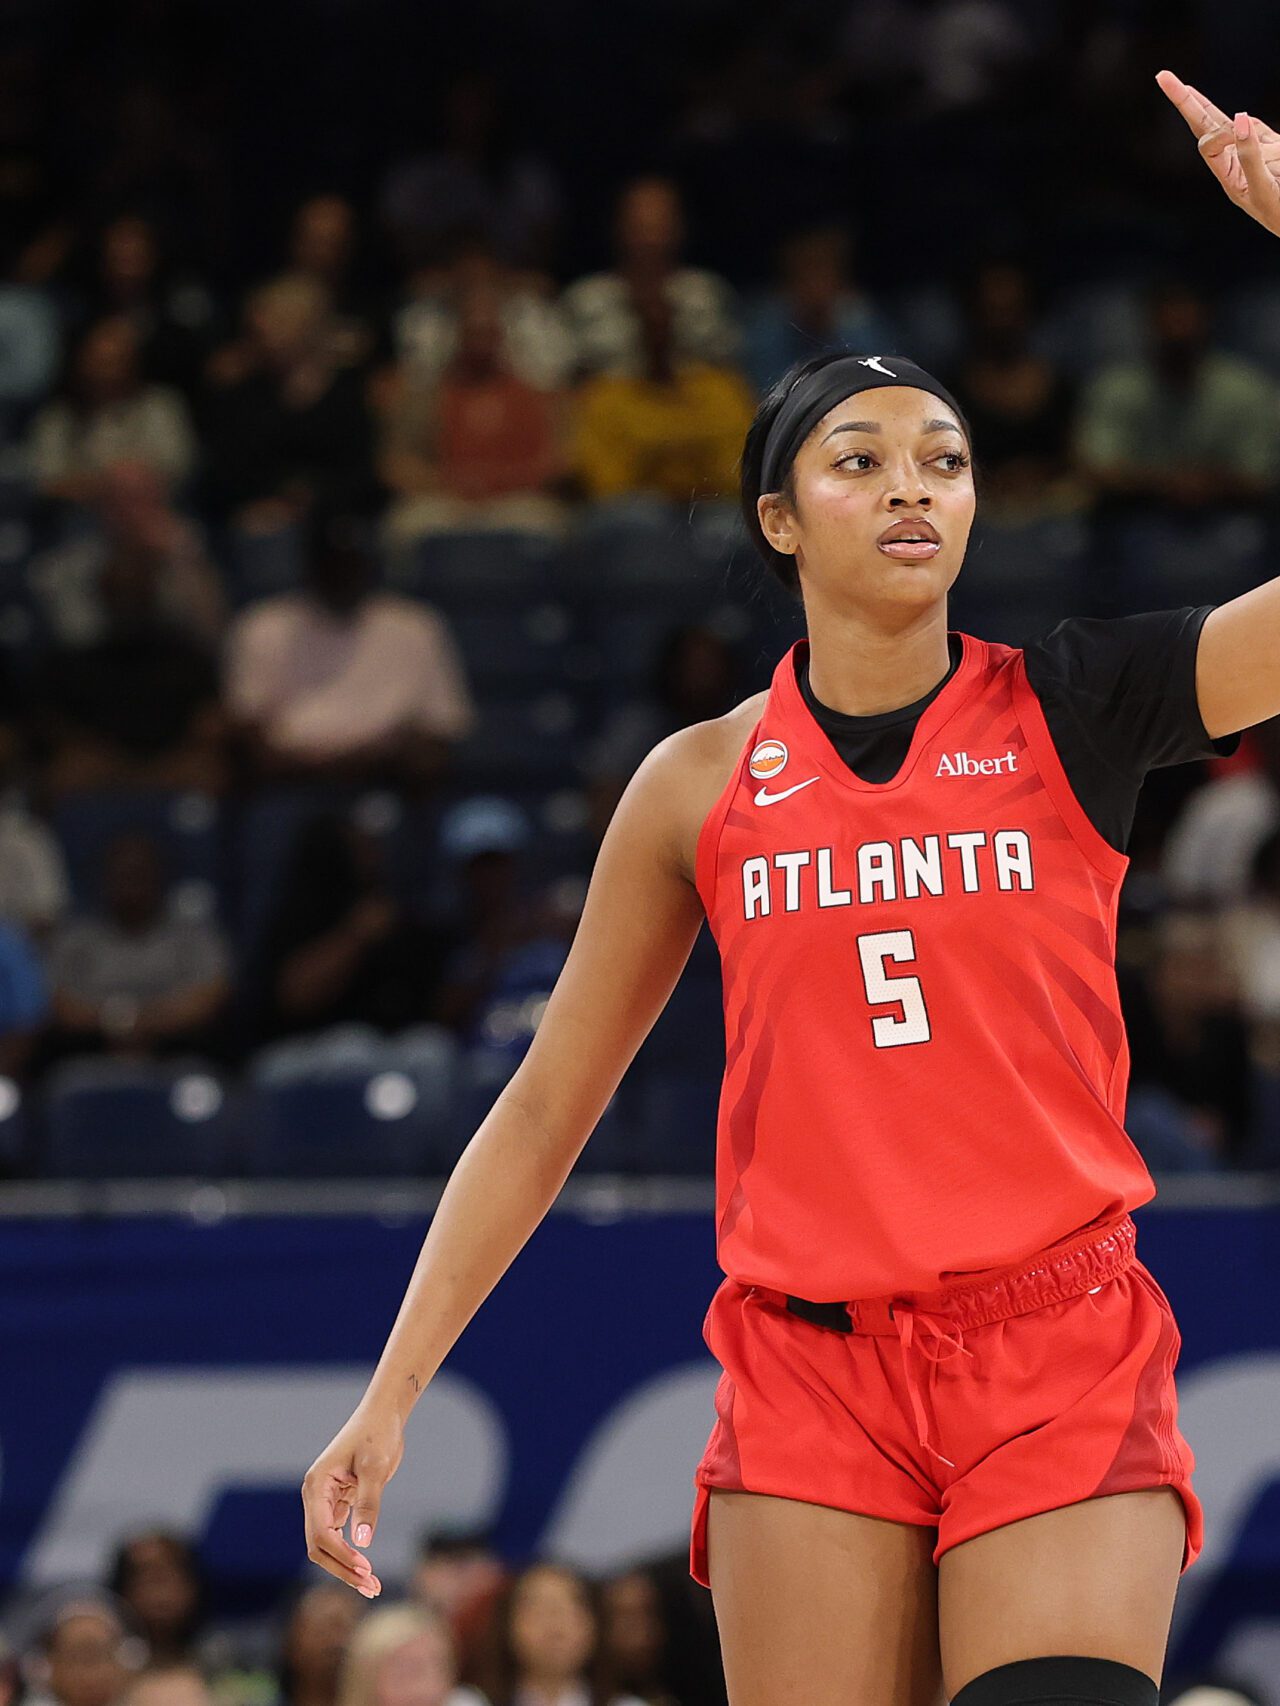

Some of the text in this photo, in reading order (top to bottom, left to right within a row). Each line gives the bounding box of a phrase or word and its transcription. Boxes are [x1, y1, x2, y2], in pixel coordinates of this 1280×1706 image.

[935, 750, 1018, 777] Albert
[741, 829, 1034, 920] ATLANTA
[856, 928, 931, 1049] 5
